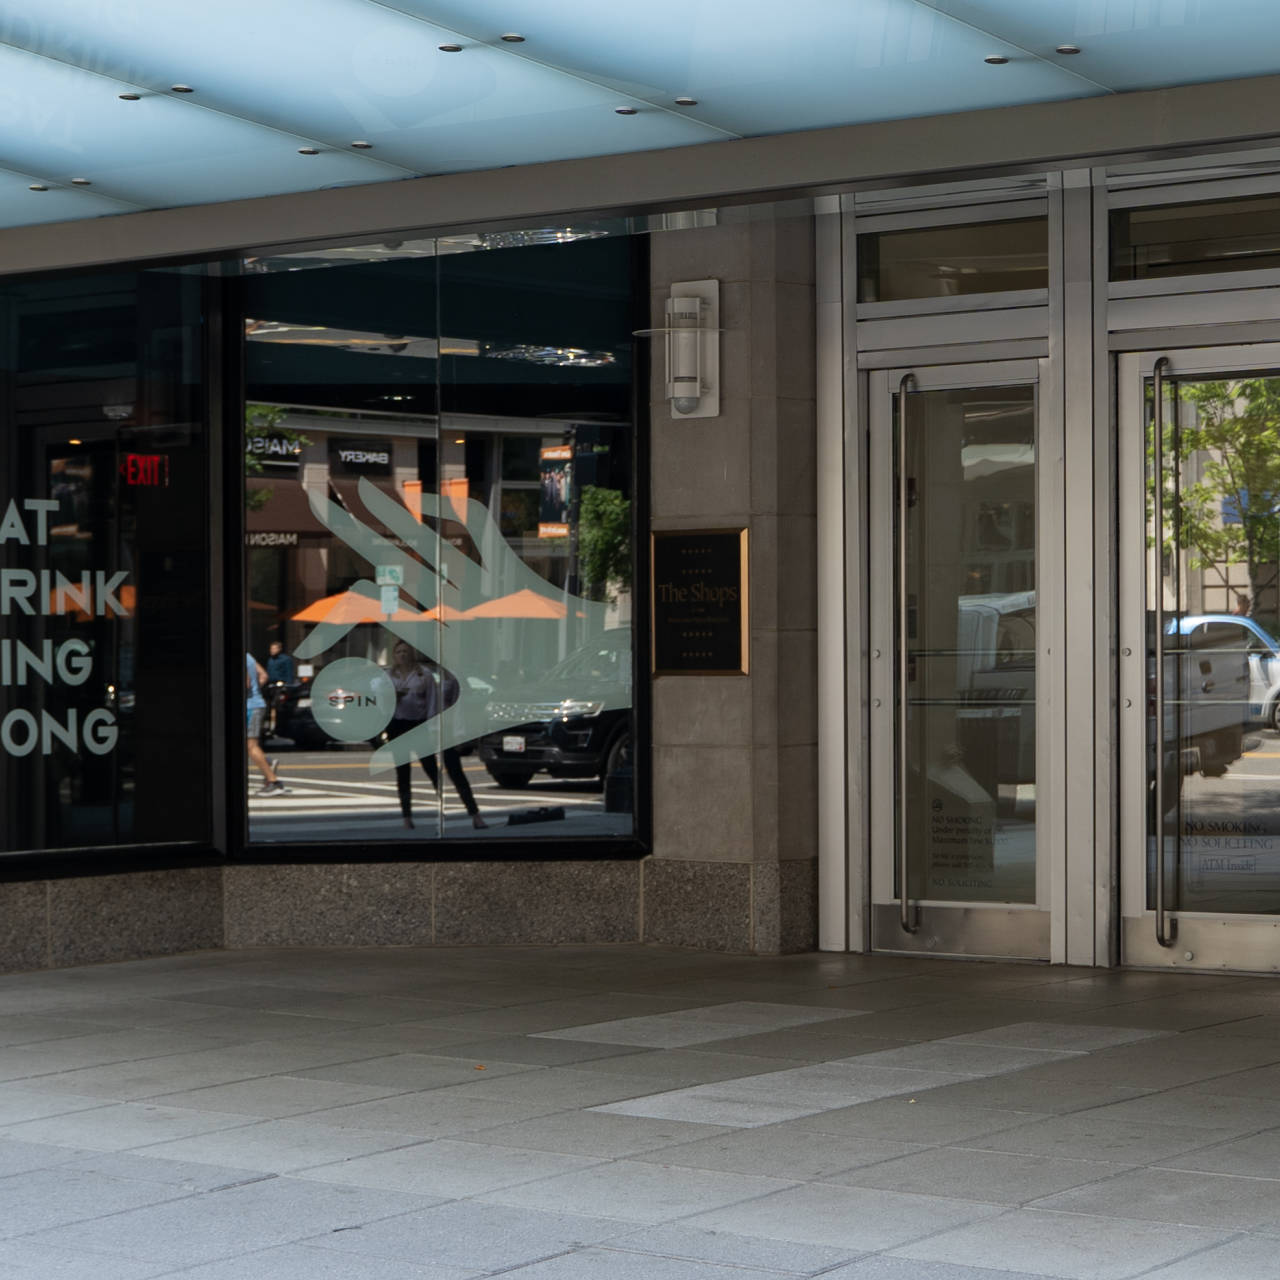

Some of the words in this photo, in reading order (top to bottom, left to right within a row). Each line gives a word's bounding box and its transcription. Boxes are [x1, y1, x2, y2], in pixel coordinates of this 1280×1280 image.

[128, 454, 161, 486] EXIT
[328, 696, 377, 707] SPIN
[1185, 821, 1205, 832] NO
[1208, 821, 1267, 833] SMOKING
[1180, 838, 1198, 847] NO
[1201, 838, 1273, 849] SOLICITING
